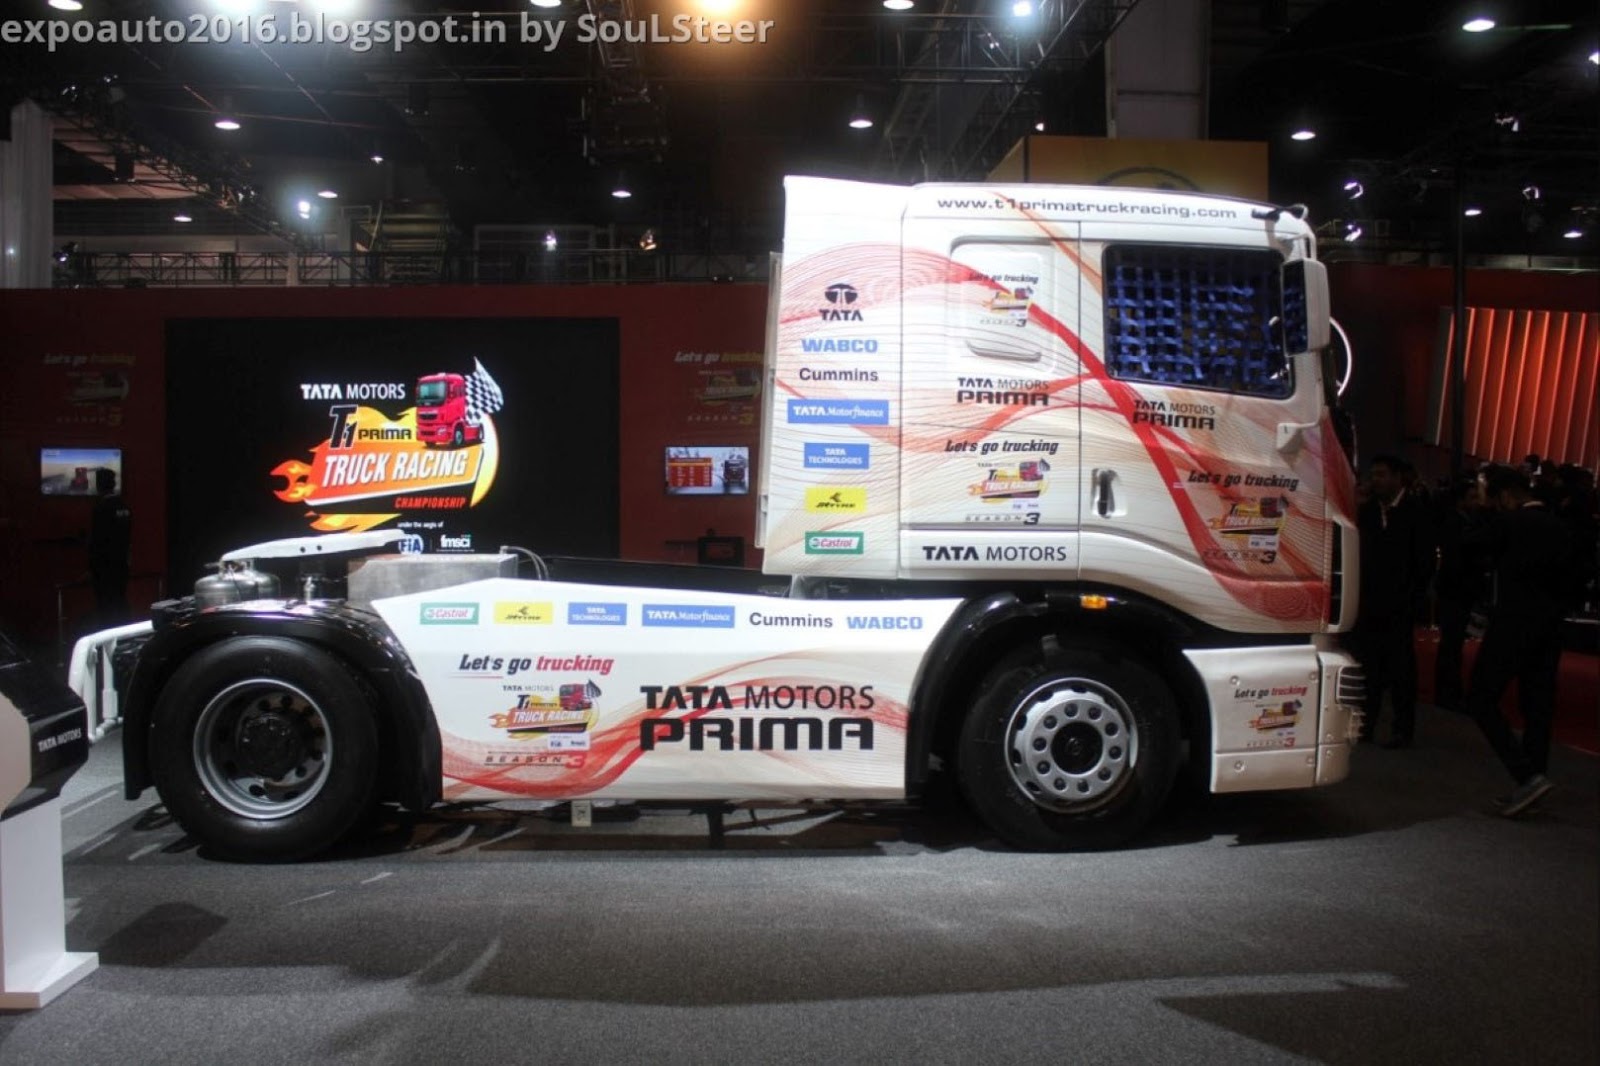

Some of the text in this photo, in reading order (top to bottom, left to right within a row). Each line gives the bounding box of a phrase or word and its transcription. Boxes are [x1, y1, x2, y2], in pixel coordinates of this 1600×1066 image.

[937, 198, 1237, 219] www.t1primatruckracing.com
[819, 309, 863, 321] TATA
[801, 339, 878, 353] WABCO
[799, 367, 878, 381] Cummins
[958, 378, 1049, 390] TATA MOTORS
[301, 383, 406, 400] TATA MOTORS
[957, 391, 1049, 406] PRIMA
[793, 406, 826, 417] TATA
[1135, 401, 1216, 416] TATA MOTORS
[1133, 412, 1216, 430] PRIMA
[358, 428, 412, 440] PRIMA
[825, 448, 846, 456] TATA
[945, 440, 1060, 455] Let's go trucking
[808, 456, 863, 465] TECHNOLOGIES
[321, 449, 468, 487] TRUCK RACING
[1188, 470, 1299, 491] Let's go trucking
[395, 497, 467, 509] CHAMPIONSHIP
[1023, 512, 1041, 526] 3
[820, 538, 853, 549] Castrol
[922, 546, 1067, 561] TATA MOTORS
[647, 610, 678, 621] TATA
[749, 612, 833, 628] Cummins
[847, 616, 923, 629] WABCO
[459, 654, 614, 675] Let's go trucking
[640, 685, 875, 710] TATA MOTORS
[1257, 689, 1269, 699] go
[1271, 686, 1308, 696] trucking
[512, 711, 544, 724] TRUCK
[37, 728, 82, 753] TATA MOTORS
[640, 717, 874, 750] PRIMA
[485, 752, 587, 768] SEASON 3
